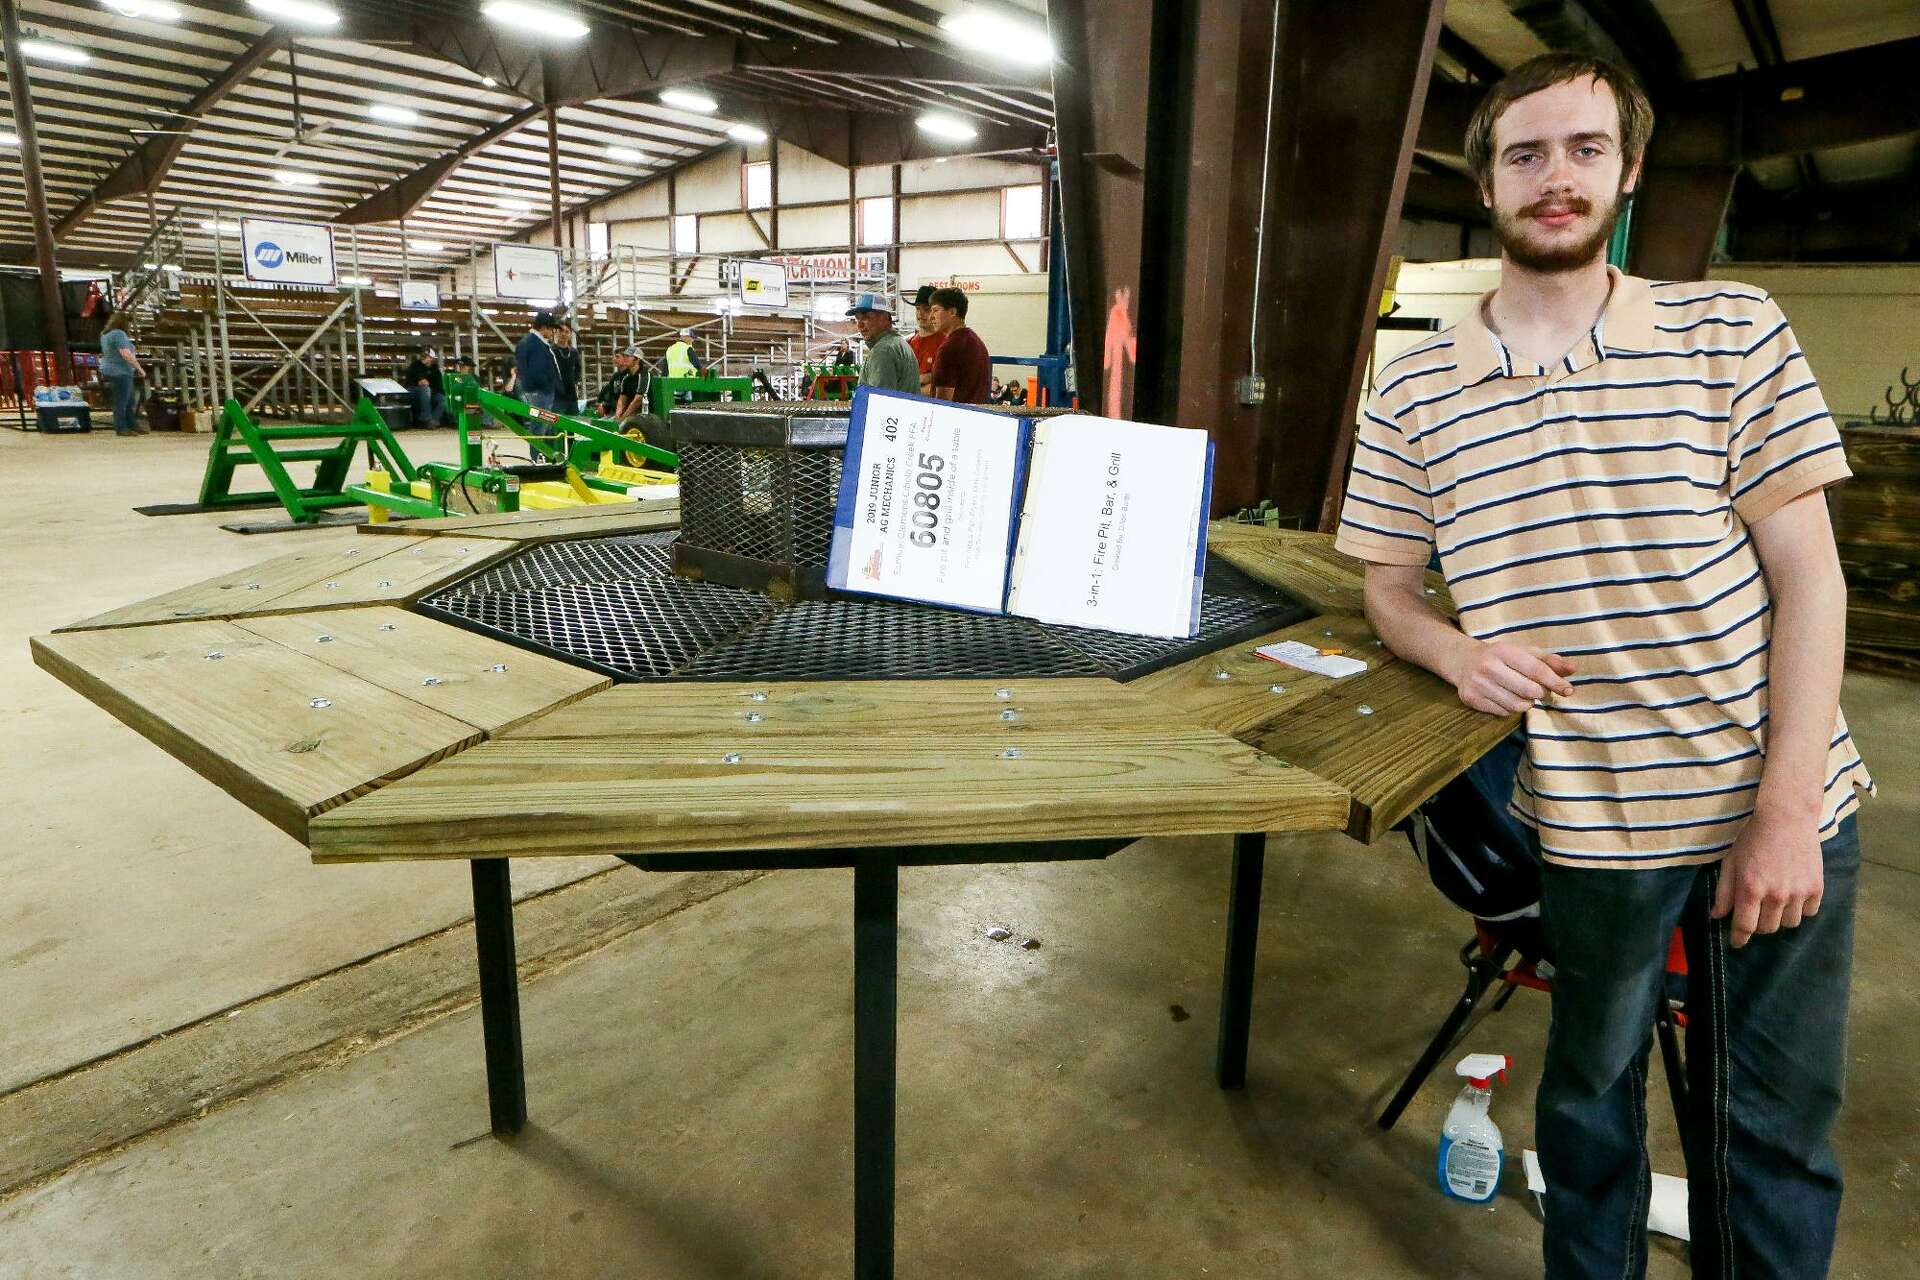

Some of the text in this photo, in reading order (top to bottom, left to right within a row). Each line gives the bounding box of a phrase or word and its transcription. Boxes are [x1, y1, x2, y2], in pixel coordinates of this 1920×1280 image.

[286, 251, 323, 265] Miller
[813, 256, 869, 278] MONH
[885, 417, 899, 442] 402
[948, 462, 958, 473] of
[1108, 452, 1121, 476] Grill
[866, 463, 882, 525] 2019 JUNIOR
[879, 457, 896, 534] AG MECHANICS
[945, 474, 957, 502] inside
[1106, 480, 1117, 488] &
[909, 453, 945, 548] 60805
[943, 504, 954, 525] grill
[942, 527, 951, 546] and
[1093, 542, 1107, 564] Fire
[1086, 569, 1102, 607] 3-in-1:
